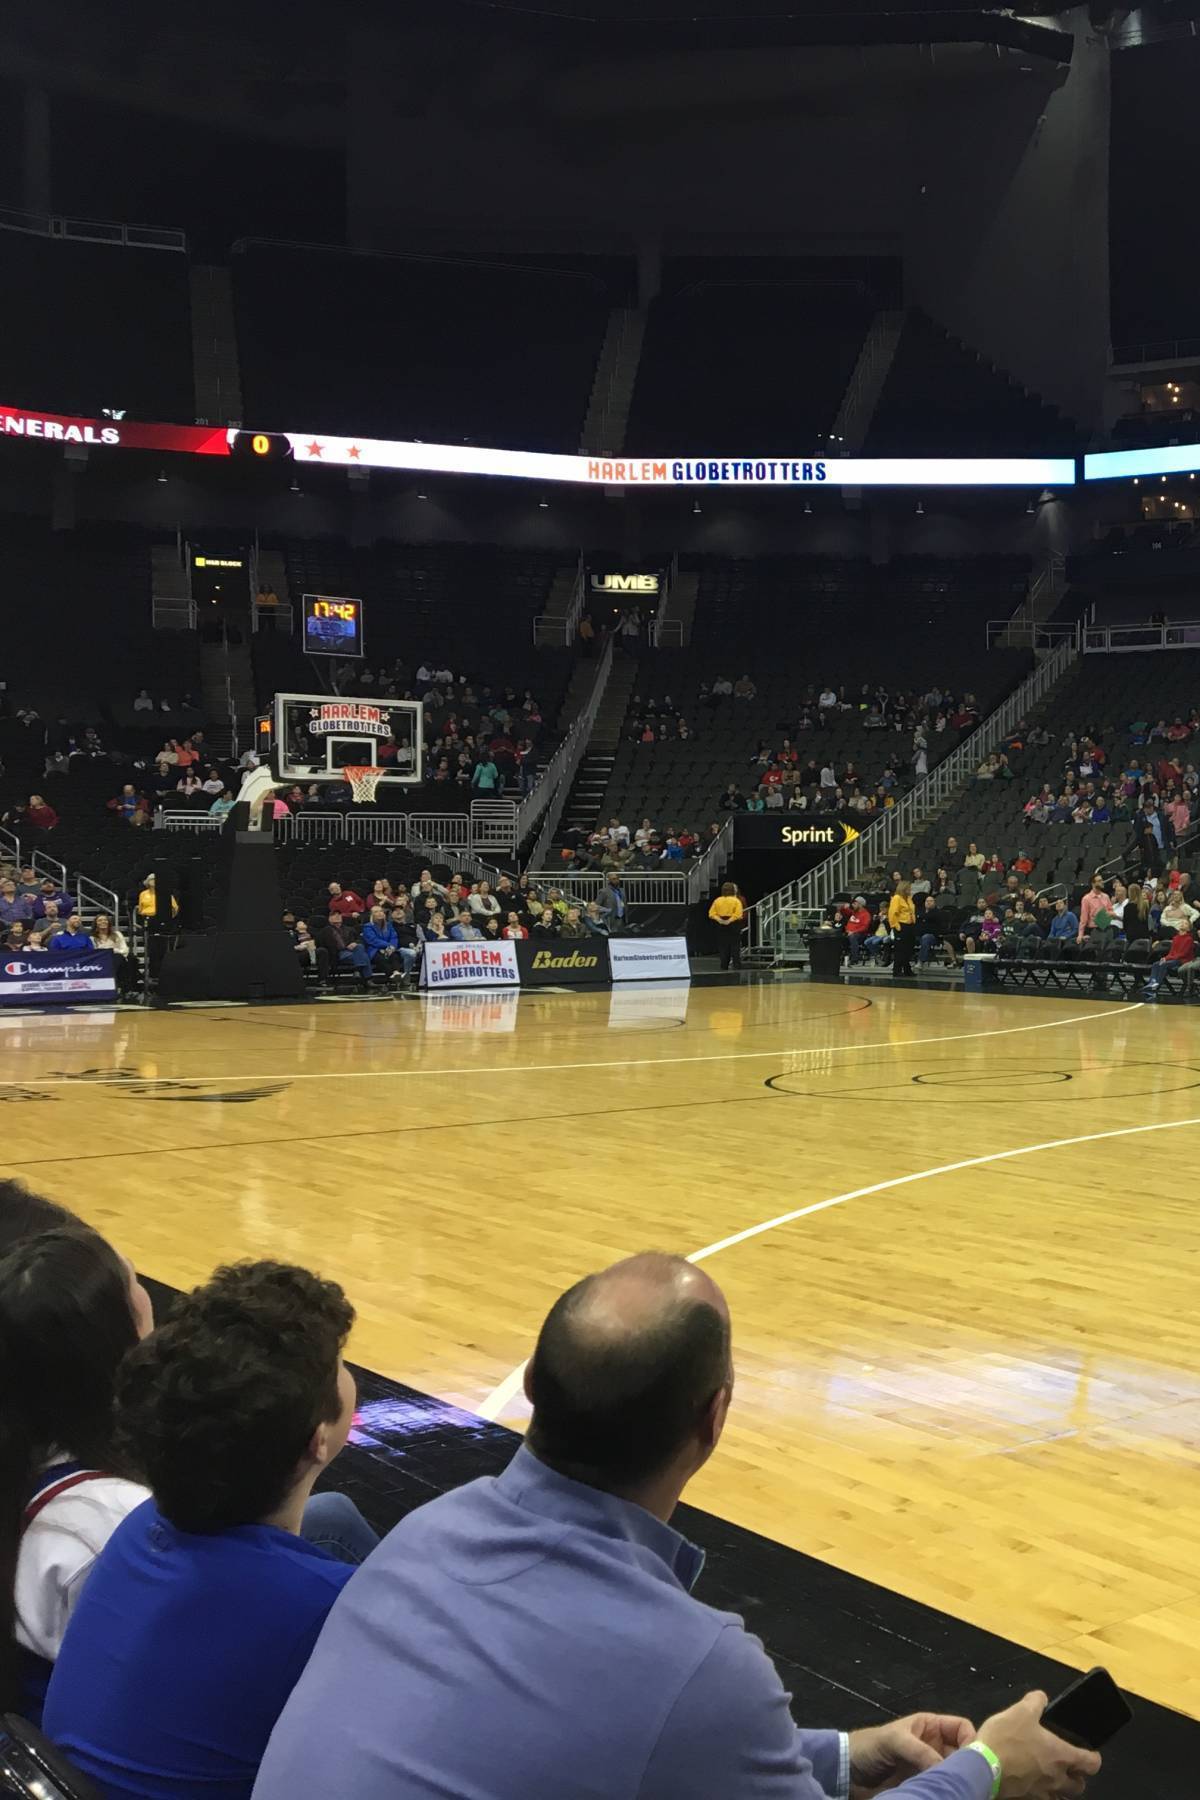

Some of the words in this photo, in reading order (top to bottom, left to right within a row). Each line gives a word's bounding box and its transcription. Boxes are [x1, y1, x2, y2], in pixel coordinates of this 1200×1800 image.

[0, 415, 120, 444] NERALS
[252, 435, 269, 454] 0
[588, 461, 667, 480] HARLEM
[672, 461, 827, 480] GLOBETROTTERS
[590, 574, 659, 590] UMB
[314, 602, 355, 620] 17:42
[321, 704, 380, 722] HARLEM
[309, 720, 392, 737] GLOBETROTTERS
[781, 826, 834, 846] Sprint
[441, 950, 502, 968] HARLEM
[531, 950, 598, 969] Baden
[4, 961, 103, 978] Champion
[431, 966, 516, 982] GLOBETROTTERS
